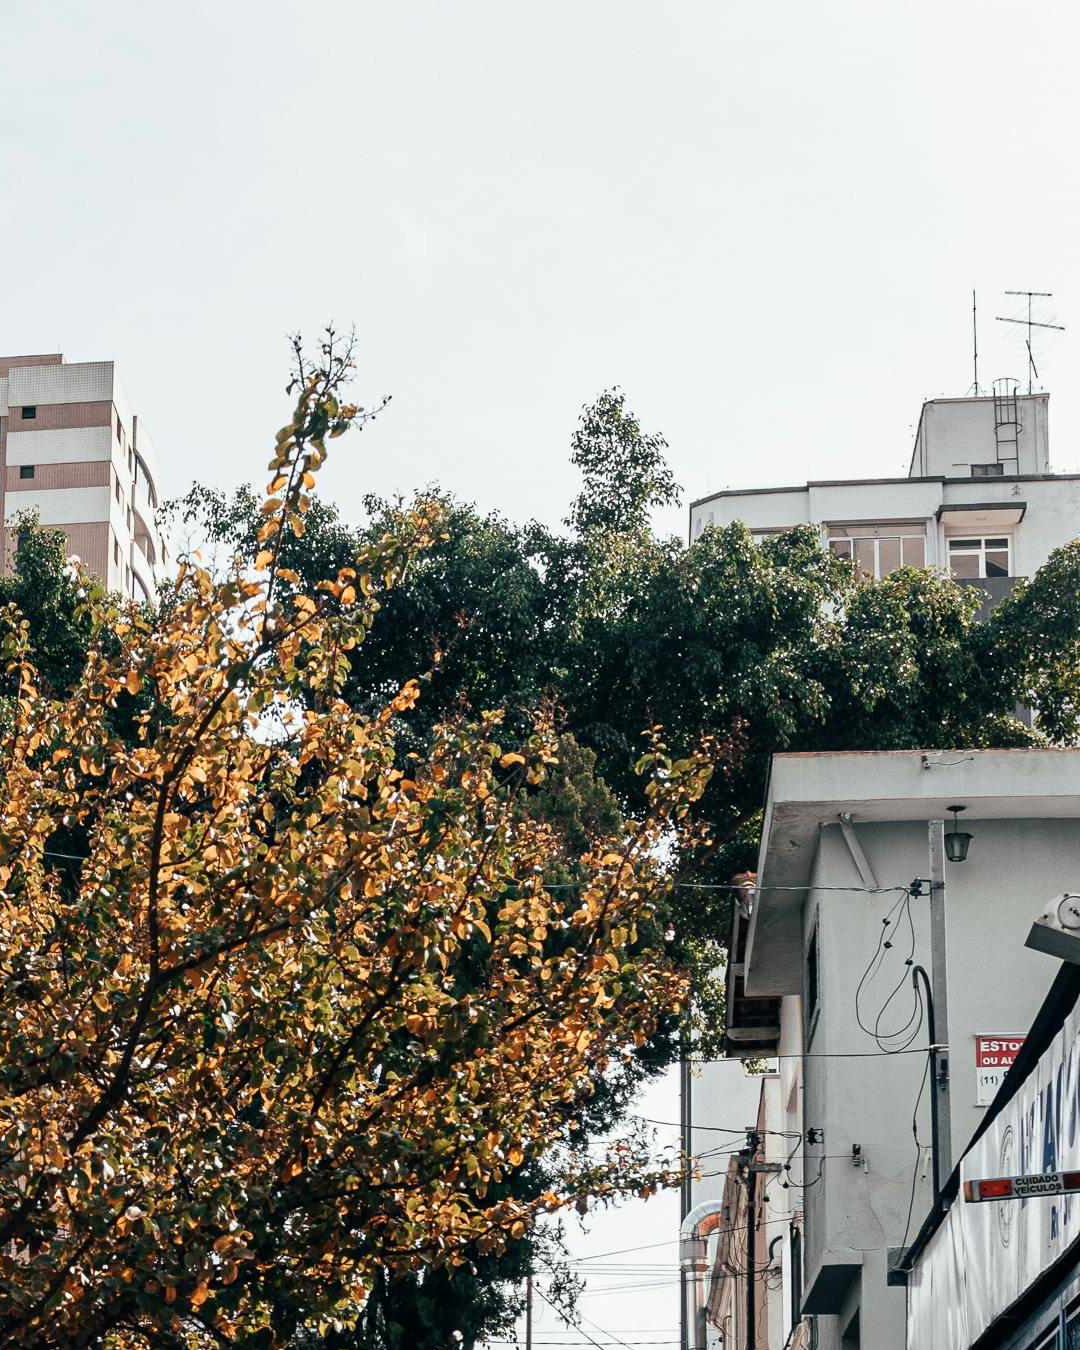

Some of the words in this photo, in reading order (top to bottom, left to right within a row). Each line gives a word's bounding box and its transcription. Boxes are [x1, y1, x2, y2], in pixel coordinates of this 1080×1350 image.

[980, 1041, 1022, 1052] ESTO
[982, 1056, 998, 1065] OU
[1001, 1056, 1014, 1065] AL
[980, 1075, 999, 1086] (11)
[1015, 1175, 1058, 1186] CUIDADO
[1013, 1183, 1062, 1195] VEÍCULOS
